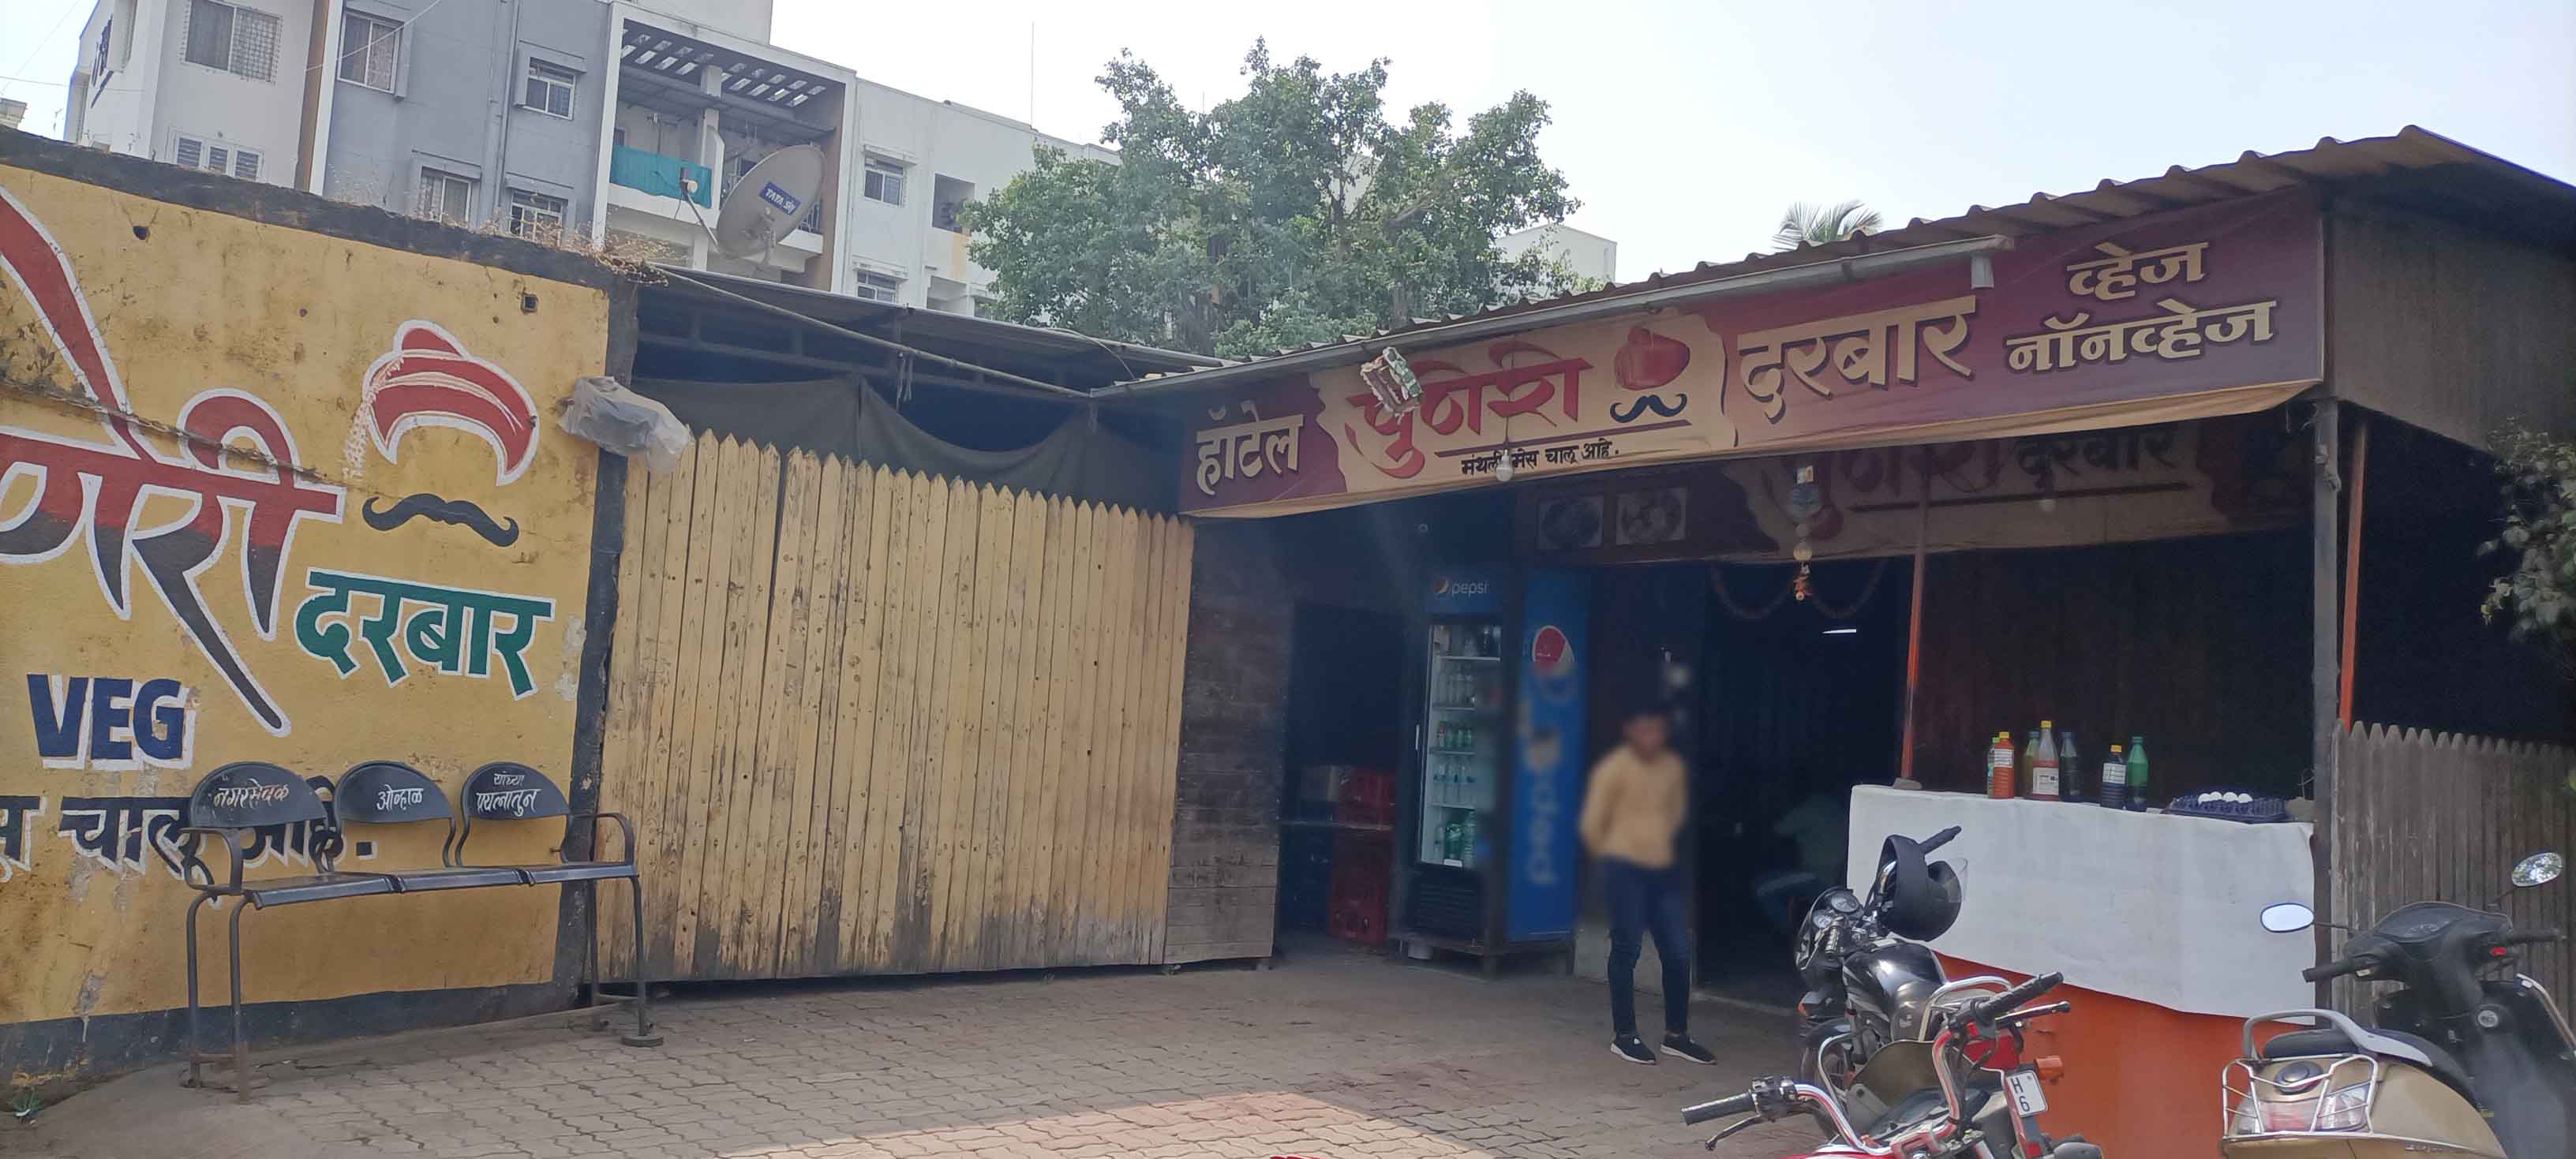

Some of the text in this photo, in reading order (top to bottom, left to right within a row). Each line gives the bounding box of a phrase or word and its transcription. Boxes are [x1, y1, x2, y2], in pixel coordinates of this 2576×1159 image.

[765, 188, 784, 205] TATA
[2065, 241, 2209, 301] व्हेज
[2005, 298, 2277, 372] नॉनव्हेज
[1196, 399, 1305, 496] हॉटेल
[1737, 295, 1977, 424] दरबार
[1451, 580, 1488, 598] pepsi
[294, 568, 556, 700] दरबार
[26, 673, 194, 770] VEG
